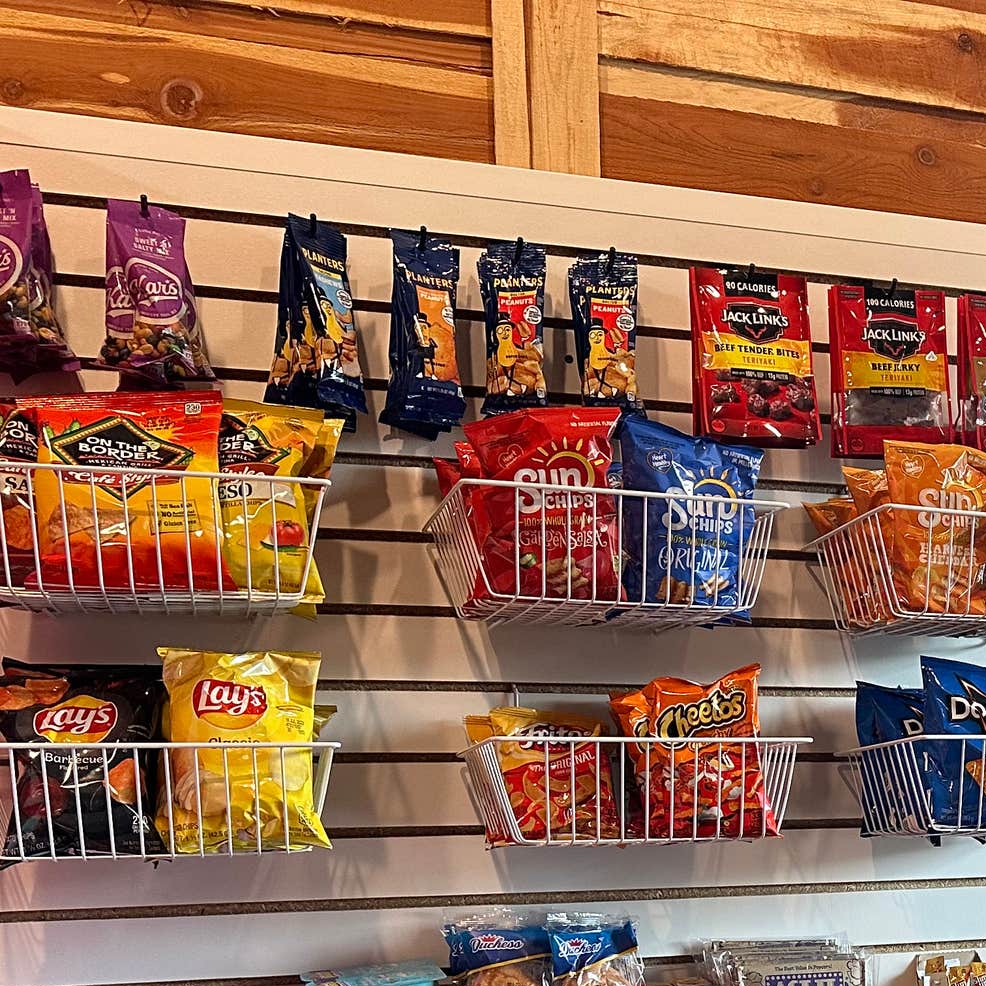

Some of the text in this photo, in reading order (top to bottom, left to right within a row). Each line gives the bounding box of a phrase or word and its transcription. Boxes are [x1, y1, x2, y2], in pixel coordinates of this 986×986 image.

[302, 247, 345, 272] PLANTERS
[405, 269, 454, 289] PLANTERS
[493, 276, 544, 289] PLANTERS
[585, 284, 635, 296] PLANTERS
[737, 281, 776, 294] CALORIES
[500, 297, 534, 306] PEANUTS
[866, 298, 914, 309] 100 CALORIES
[720, 309, 752, 323] JACK
[862, 327, 891, 341] JACK
[714, 343, 801, 359] BEEF TENDER BITES
[871, 362, 893, 371] BEEF
[78, 442, 164, 461] BORDER
[86, 435, 147, 453] ON THE
[544, 494, 594, 509] CHIPS
[688, 518, 734, 534] CHIPS
[198, 680, 266, 716] Lay's
[39, 705, 111, 735] Lay's
[659, 692, 744, 742] Cheetos
[44, 752, 105, 765] Barbecue
[469, 936, 525, 953] Duchess
